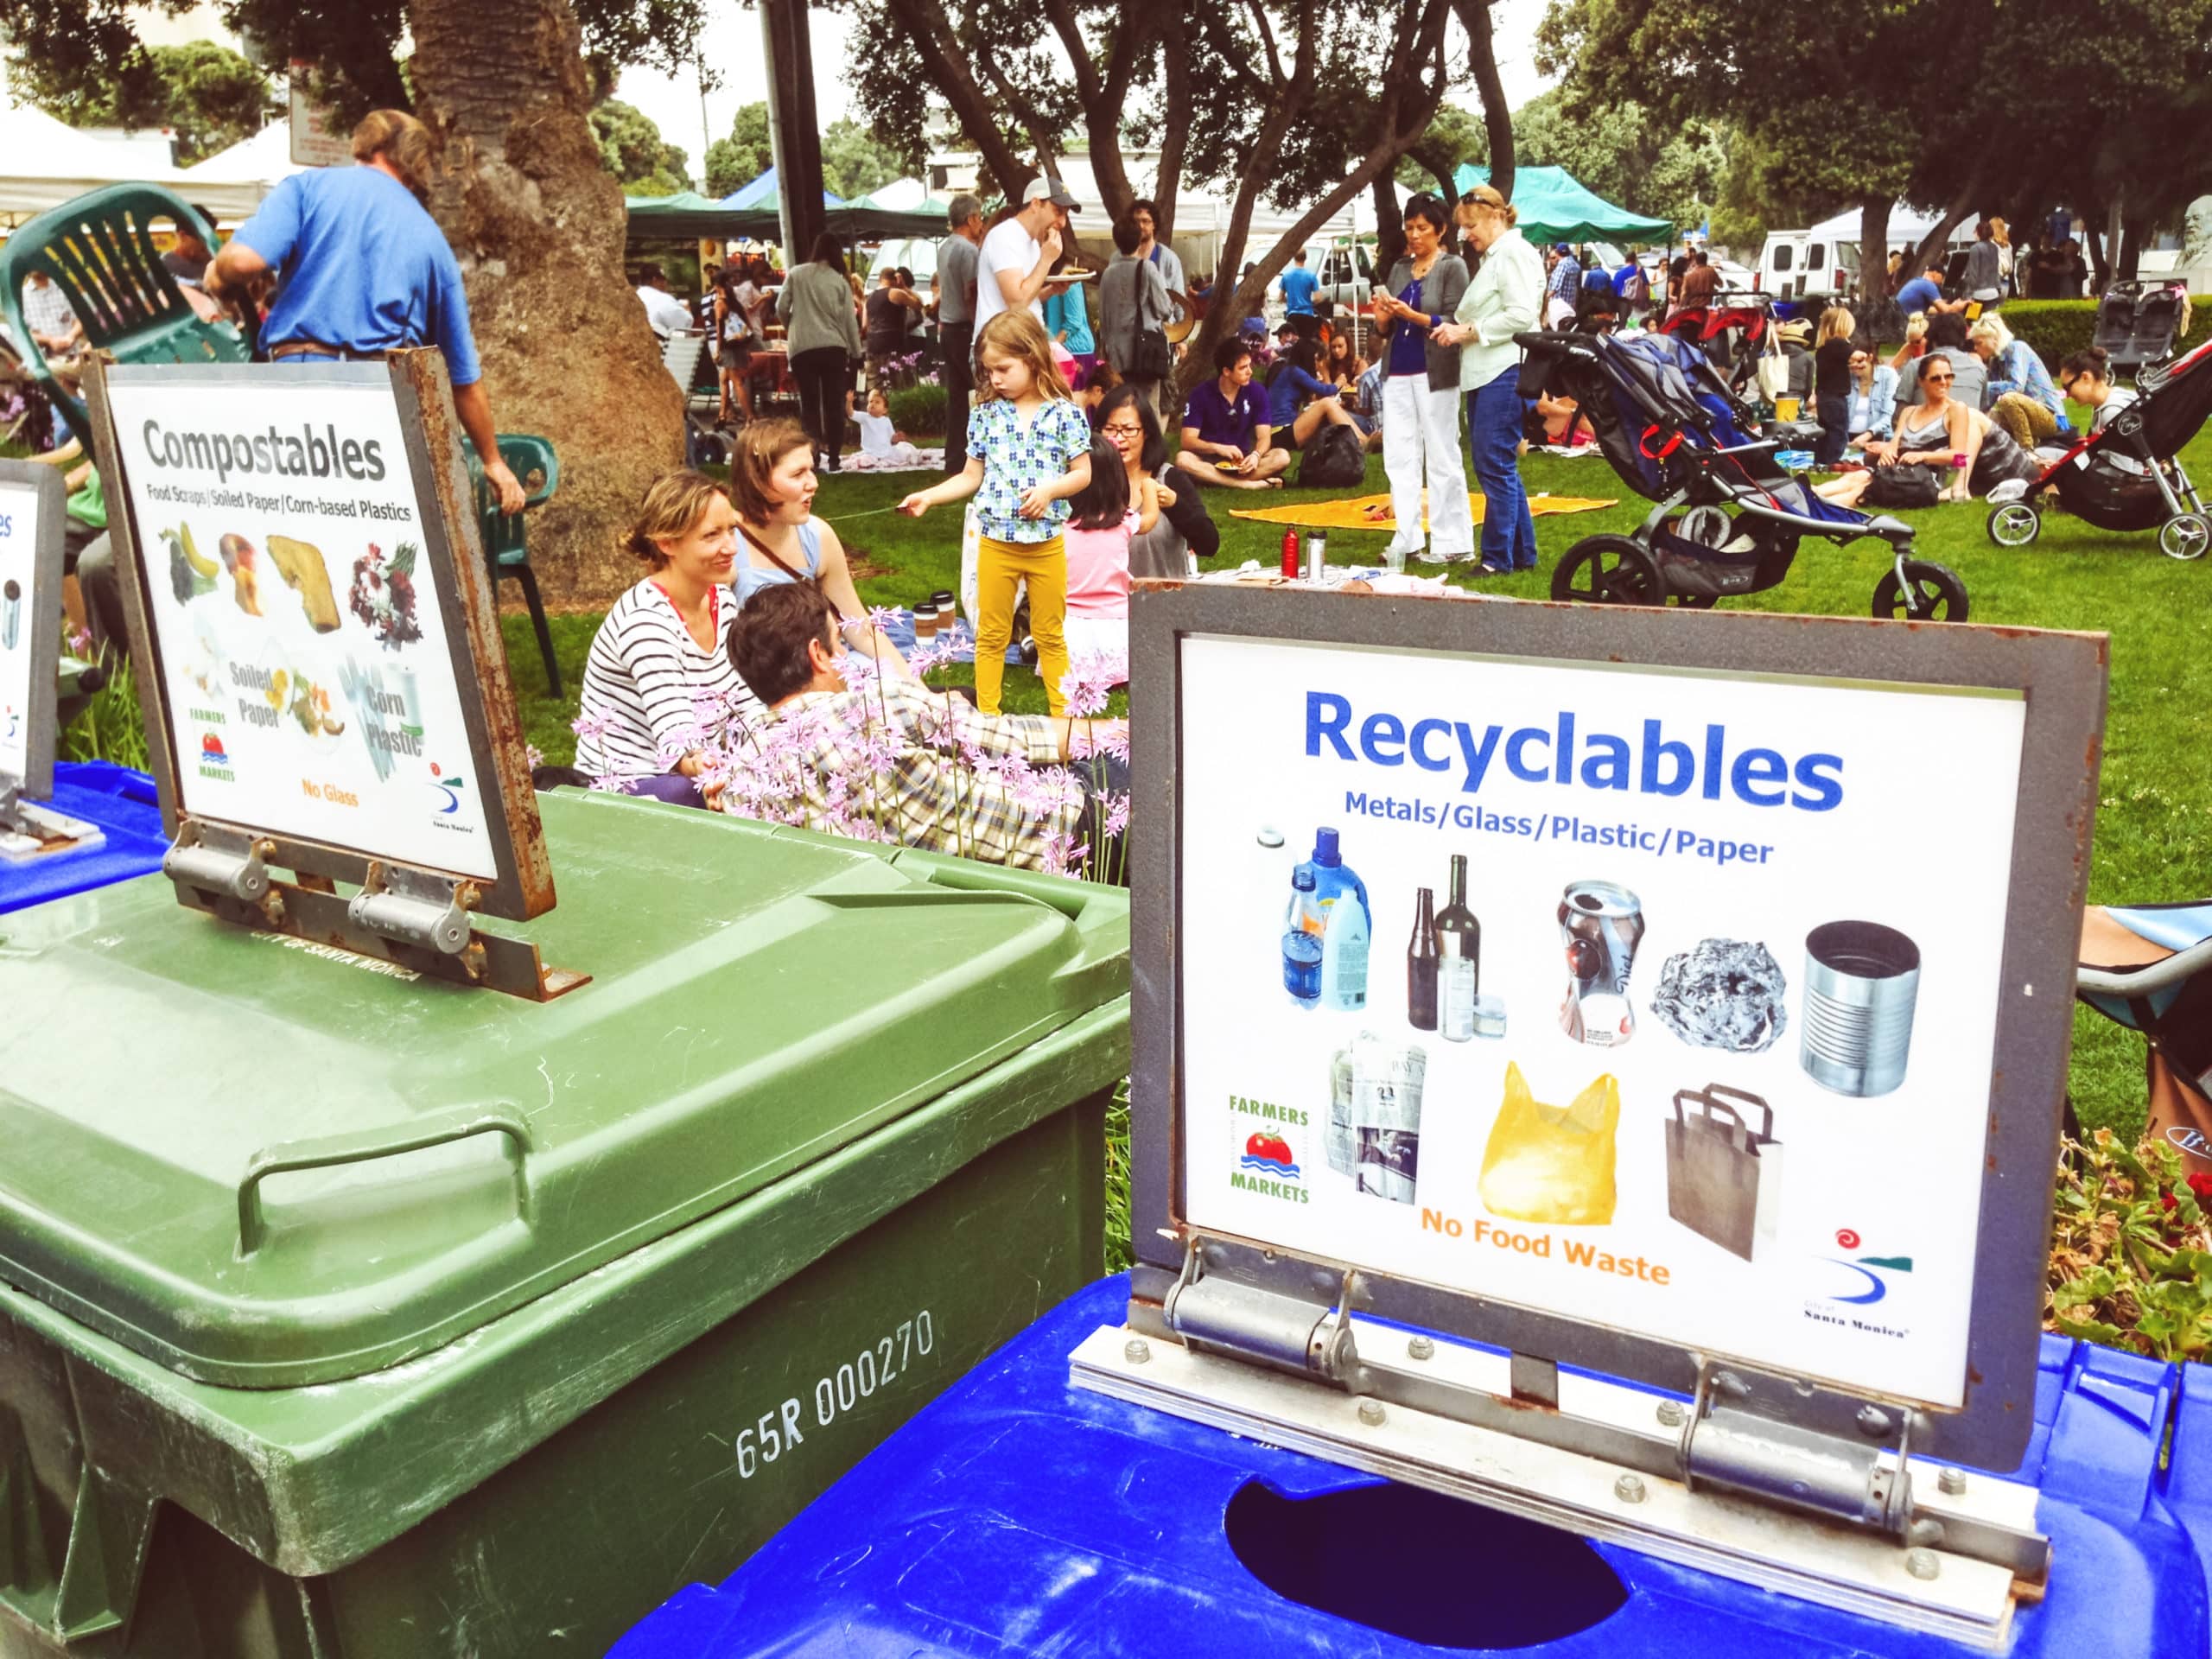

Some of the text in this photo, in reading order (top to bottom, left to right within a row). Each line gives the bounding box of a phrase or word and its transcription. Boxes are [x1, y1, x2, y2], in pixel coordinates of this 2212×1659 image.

[143, 419, 386, 484] Compostables
[146, 484, 172, 501] Food
[246, 493, 357, 518] Paper/Corn-based
[359, 500, 412, 522] Plastics
[229, 661, 275, 692] Soiled
[189, 708, 226, 724] FARMERS
[238, 697, 279, 728] Paper
[366, 685, 406, 717] Corn
[366, 721, 423, 757] Plastic
[1306, 690, 1844, 812] Recyclables
[198, 765, 235, 782] MARKETS
[302, 779, 359, 807] No Glass
[1344, 791, 1774, 865] Metals/Glass/Plastic/Paper
[304, 945, 359, 965] SANTA
[355, 959, 423, 982] MONICA
[1229, 1094, 1308, 1127] FARMERS
[1230, 1171, 1310, 1205] MARKETS
[1421, 1207, 1670, 1286] No Food Waste
[1804, 1309, 1905, 1338] Santa Monica
[736, 1309, 933, 1479] 65R 000270
